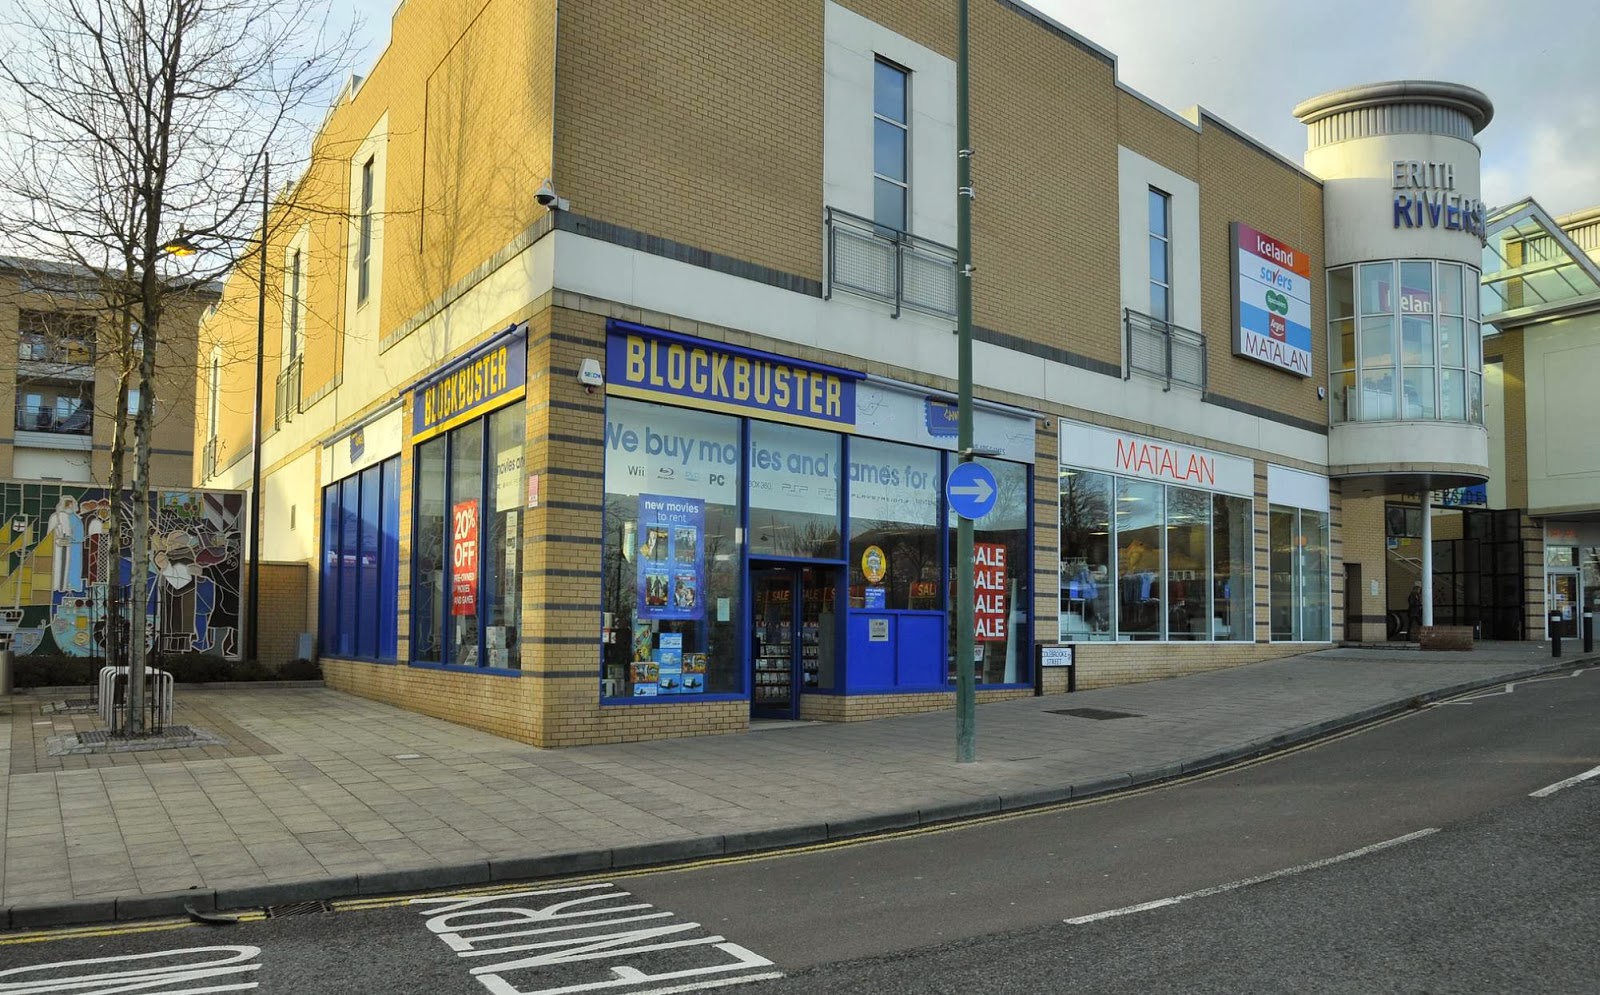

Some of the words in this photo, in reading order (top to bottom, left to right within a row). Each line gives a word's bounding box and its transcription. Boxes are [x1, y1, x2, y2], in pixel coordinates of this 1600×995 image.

[1392, 160, 1456, 191] ERITH
[1257, 235, 1294, 267] Iceland
[1260, 266, 1293, 291] savers
[1387, 289, 1442, 313] Ielan
[1270, 318, 1284, 332] Argos
[1245, 332, 1309, 373] MATALAN
[424, 345, 507, 426] BLOCKBUSTER
[626, 335, 841, 417] BLOCKBUSTER
[605, 421, 639, 453] We
[645, 426, 694, 465] buy
[699, 440, 782, 471] moies
[787, 453, 828, 477] and
[905, 465, 928, 490] for
[1116, 438, 1215, 485] MATALAN
[627, 465, 645, 477] Wii
[709, 474, 725, 487] PC
[645, 500, 664, 510] new
[667, 502, 699, 513] movies
[658, 512, 667, 521] to
[669, 513, 687, 523] rent
[454, 507, 476, 540] 20%
[454, 541, 476, 568] OFF
[973, 546, 1004, 567] ALE
[918, 583, 935, 596] SAL
[973, 570, 1004, 590] ALE
[973, 594, 1004, 614] ALE
[973, 618, 1004, 637] ALE
